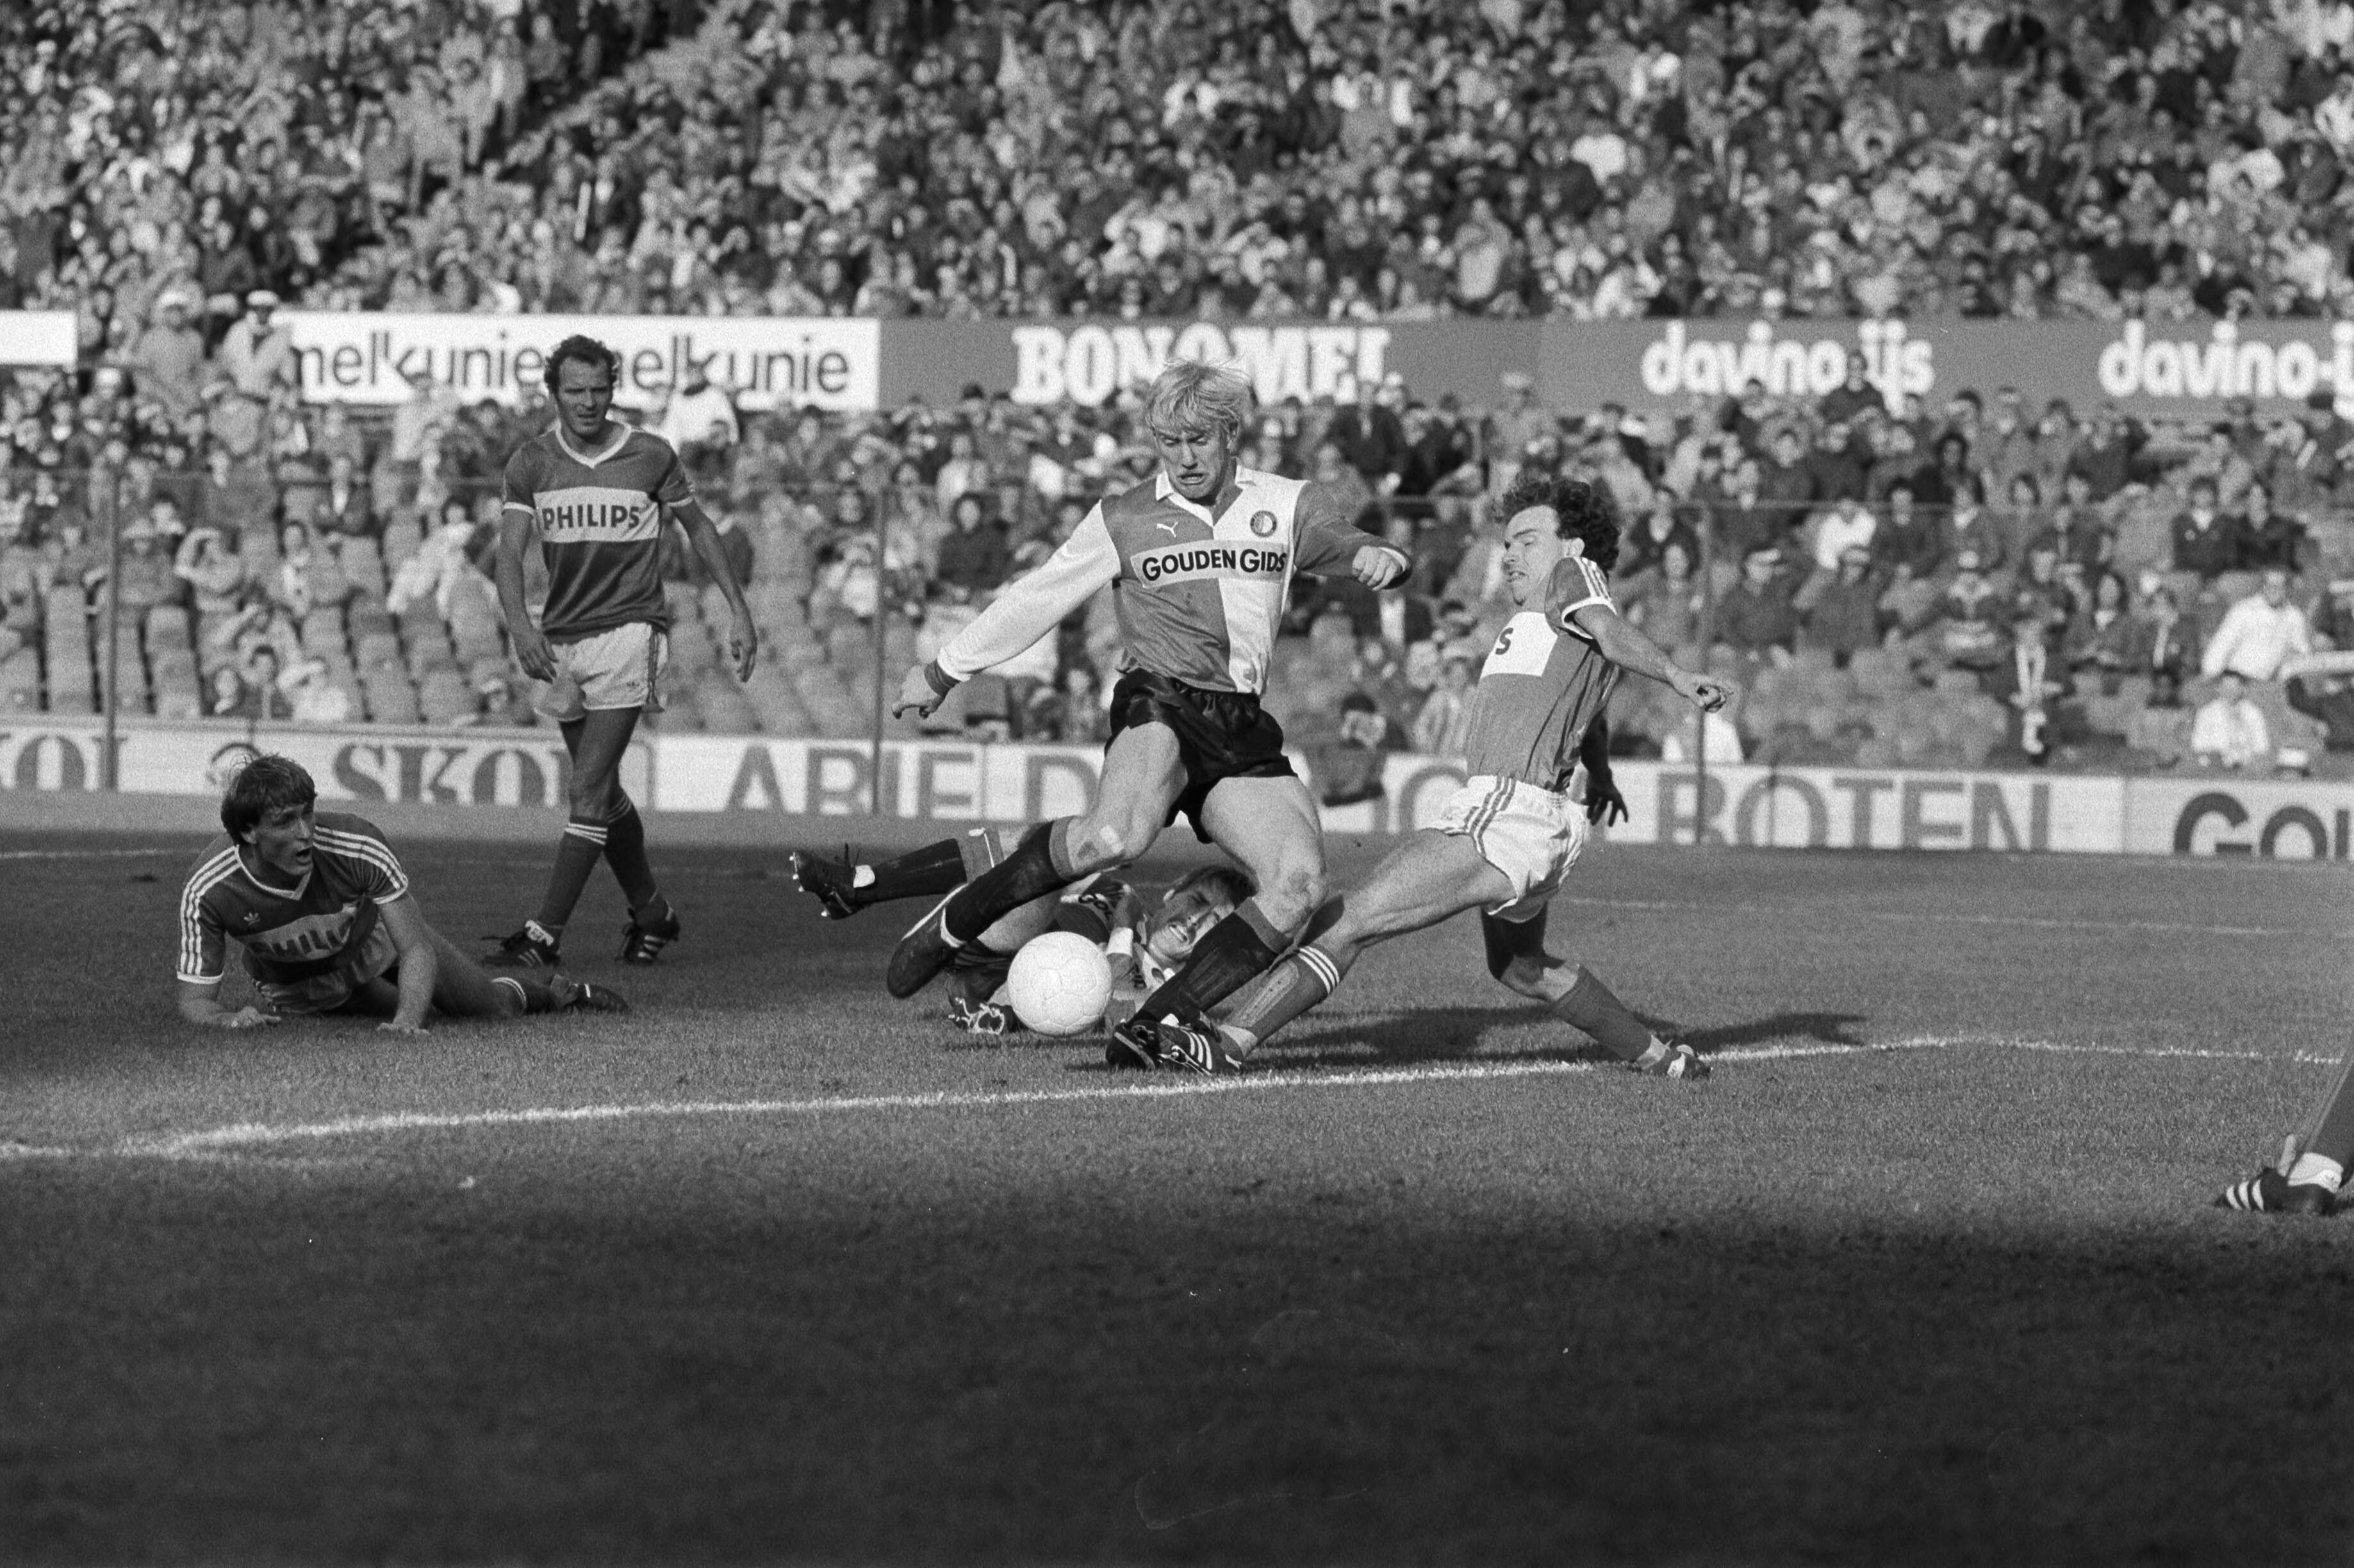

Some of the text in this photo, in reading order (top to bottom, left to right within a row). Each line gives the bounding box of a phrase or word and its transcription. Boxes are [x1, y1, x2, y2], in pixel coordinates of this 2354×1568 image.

[613, 333, 849, 393] elkunie
[1641, 320, 1848, 396] davino
[541, 503, 640, 531] PHILIPS
[1142, 548, 1288, 581] GOUDEN GIDS
